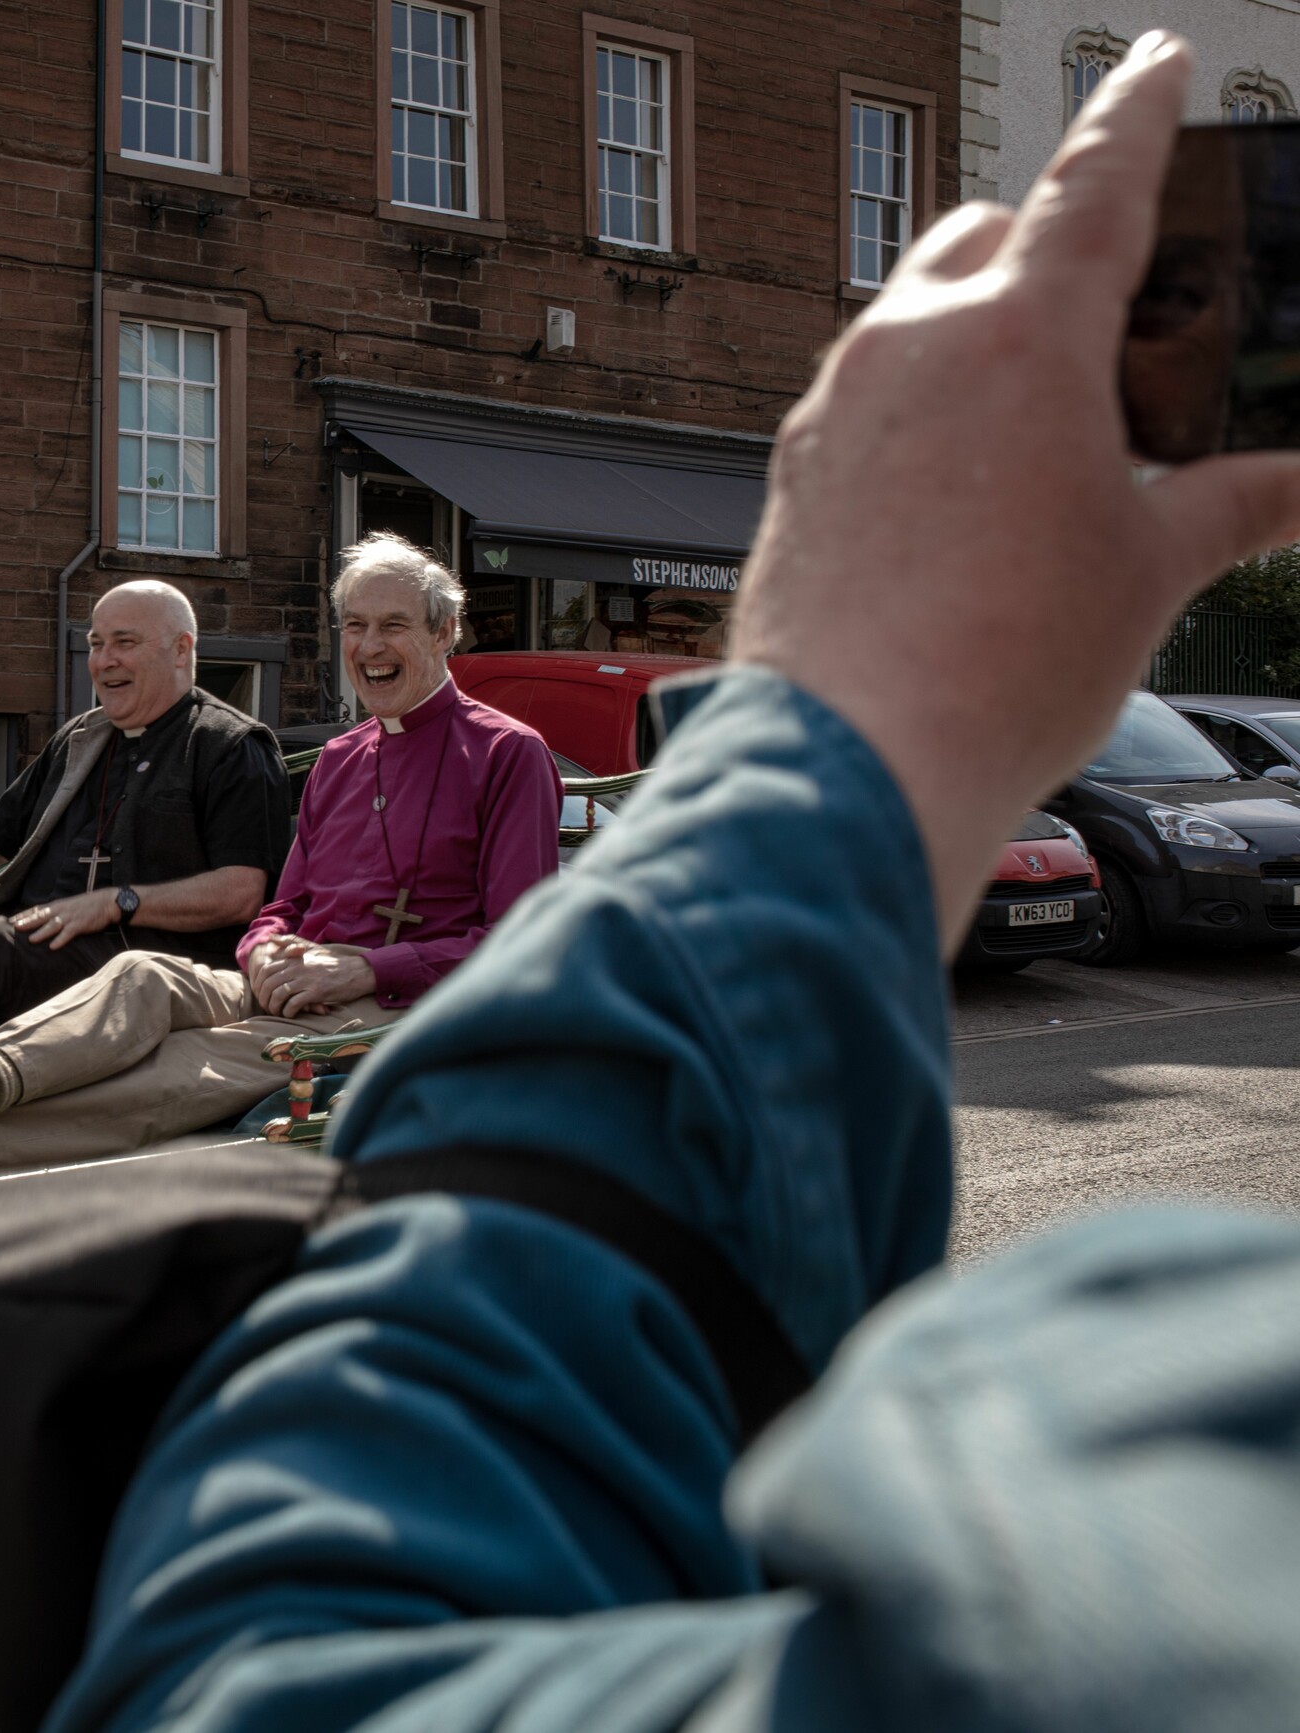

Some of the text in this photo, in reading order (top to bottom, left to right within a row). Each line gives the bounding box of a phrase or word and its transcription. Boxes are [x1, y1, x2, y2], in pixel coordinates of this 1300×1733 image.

[632, 557, 739, 591] STEPHENSONS
[476, 589, 514, 608] PRODUC
[1015, 902, 1070, 922] KW63 YCO
